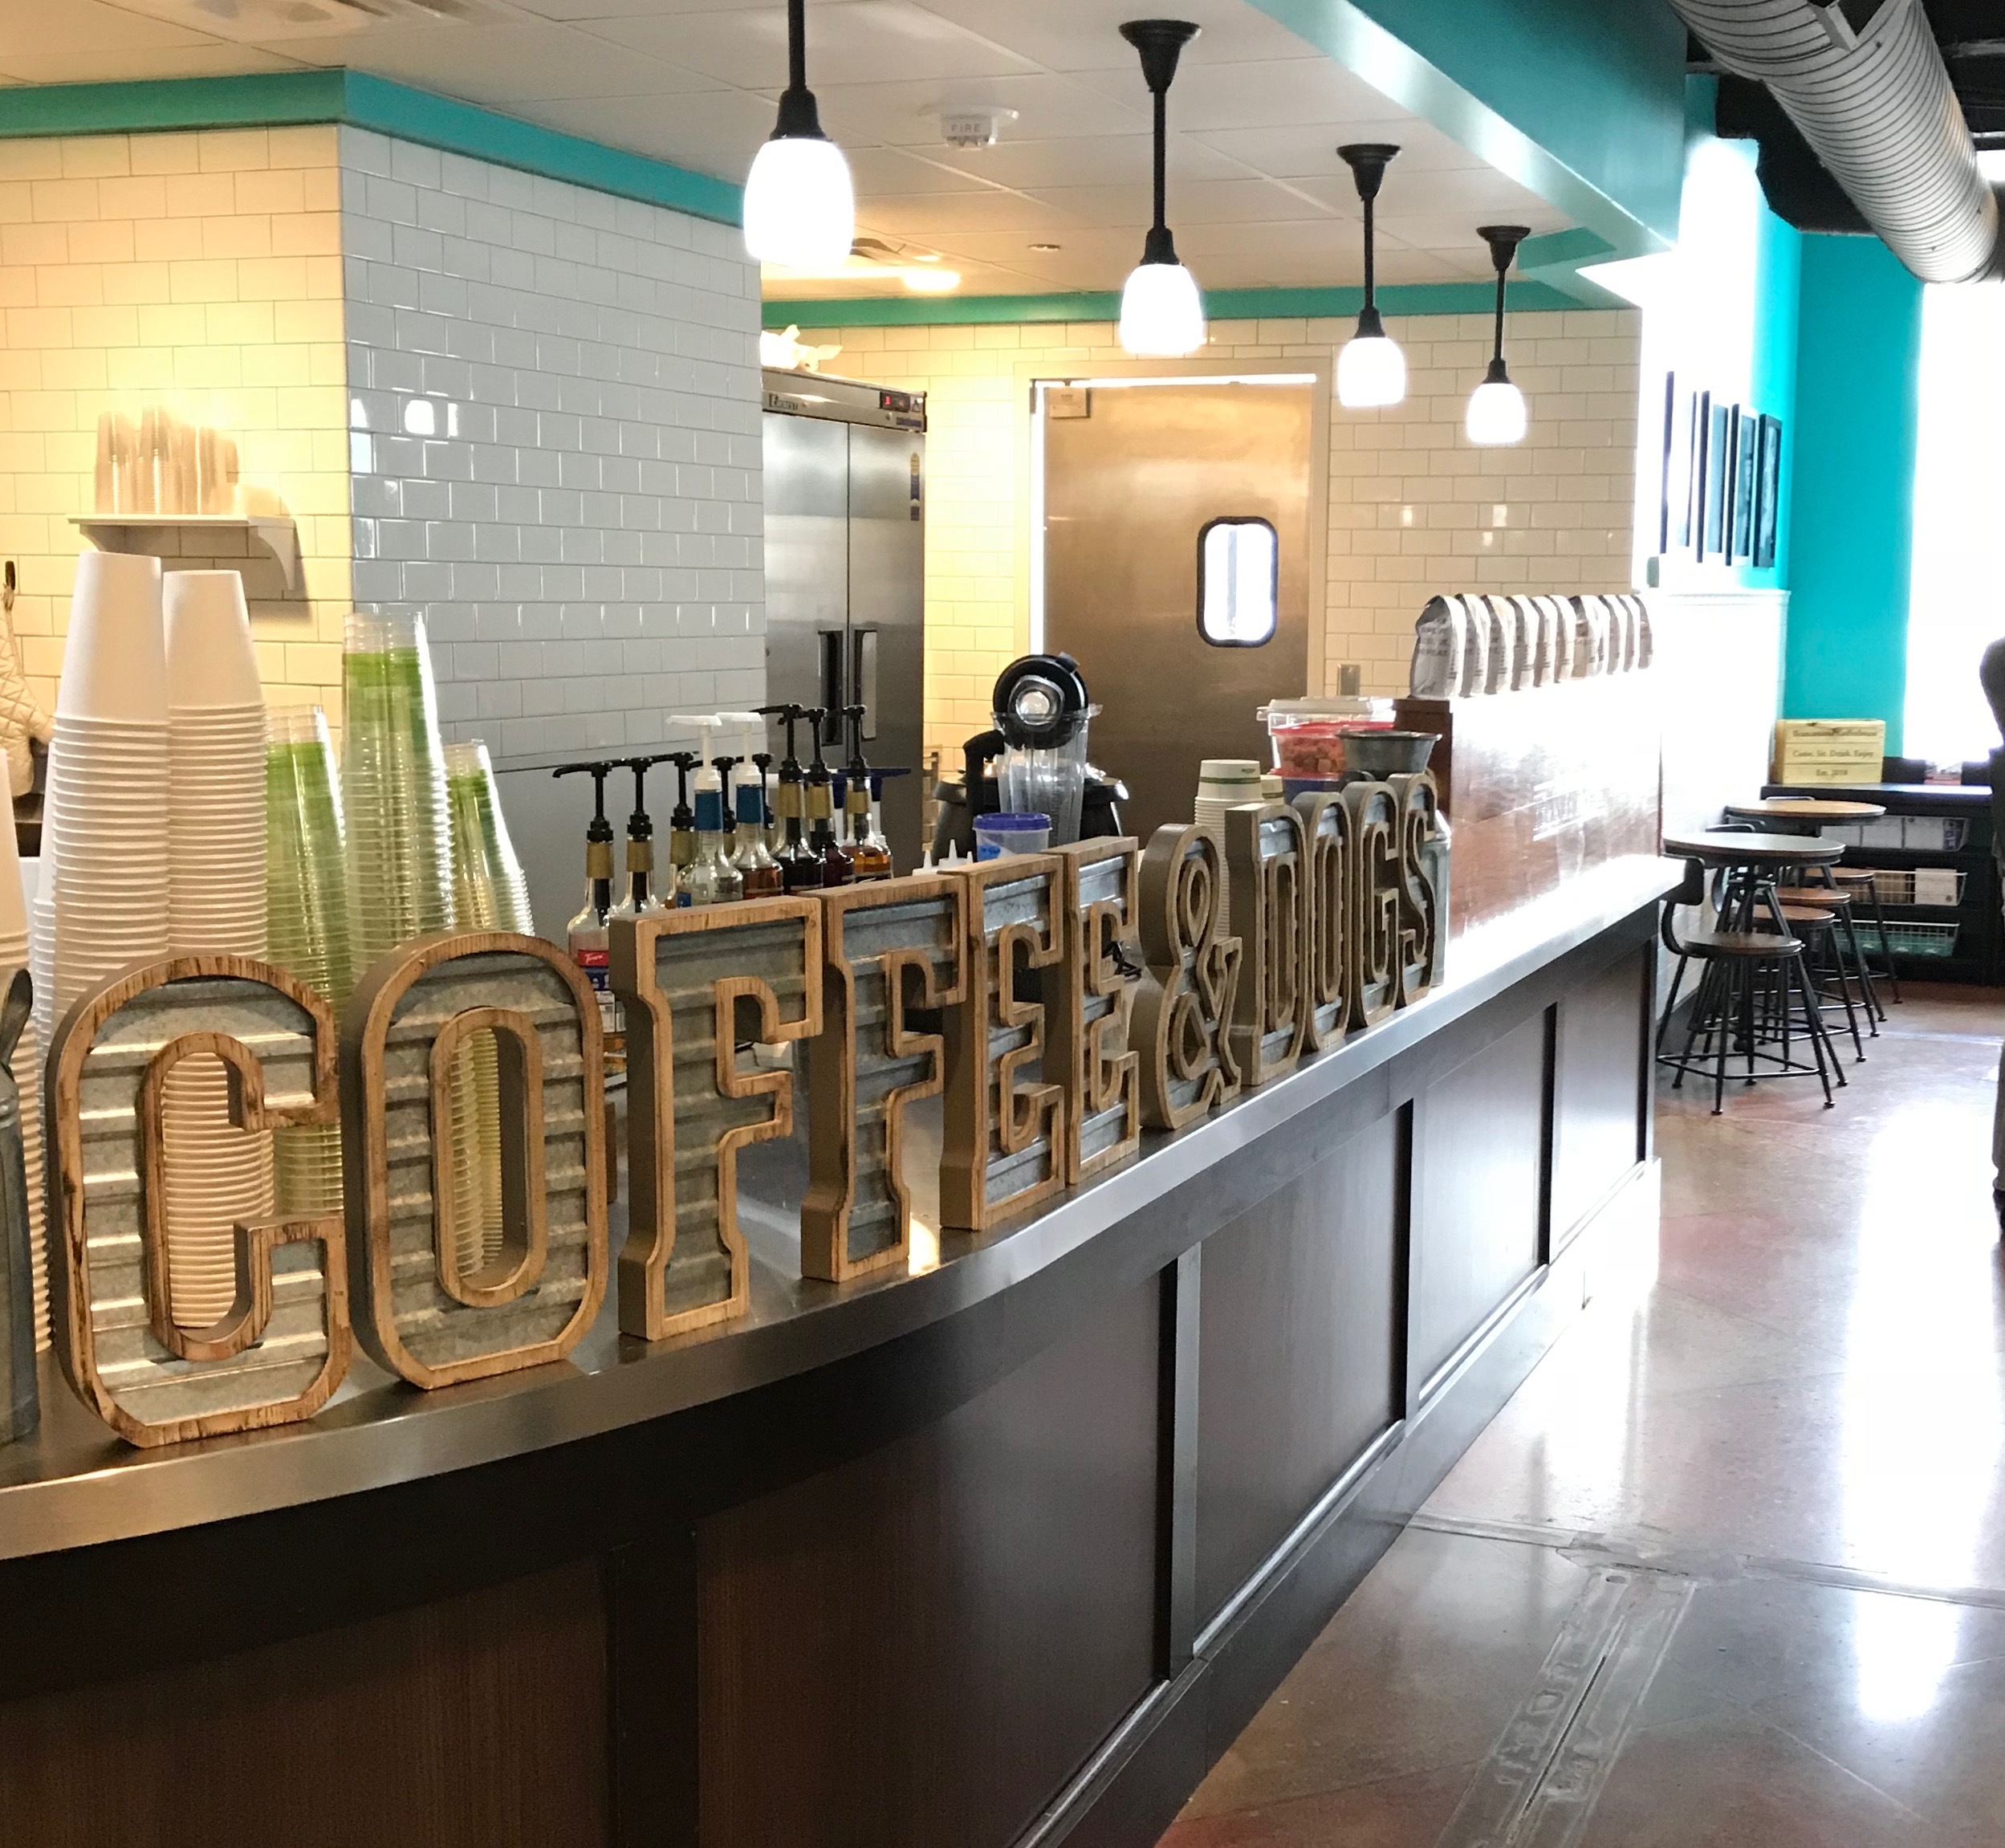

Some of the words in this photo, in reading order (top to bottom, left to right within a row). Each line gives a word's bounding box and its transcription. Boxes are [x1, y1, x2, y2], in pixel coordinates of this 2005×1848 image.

[951, 123, 981, 133] FIRE
[48, 836, 1141, 1448] COFFEE
[1129, 823, 1242, 1130] &
[1225, 772, 1439, 1086] DOGS
